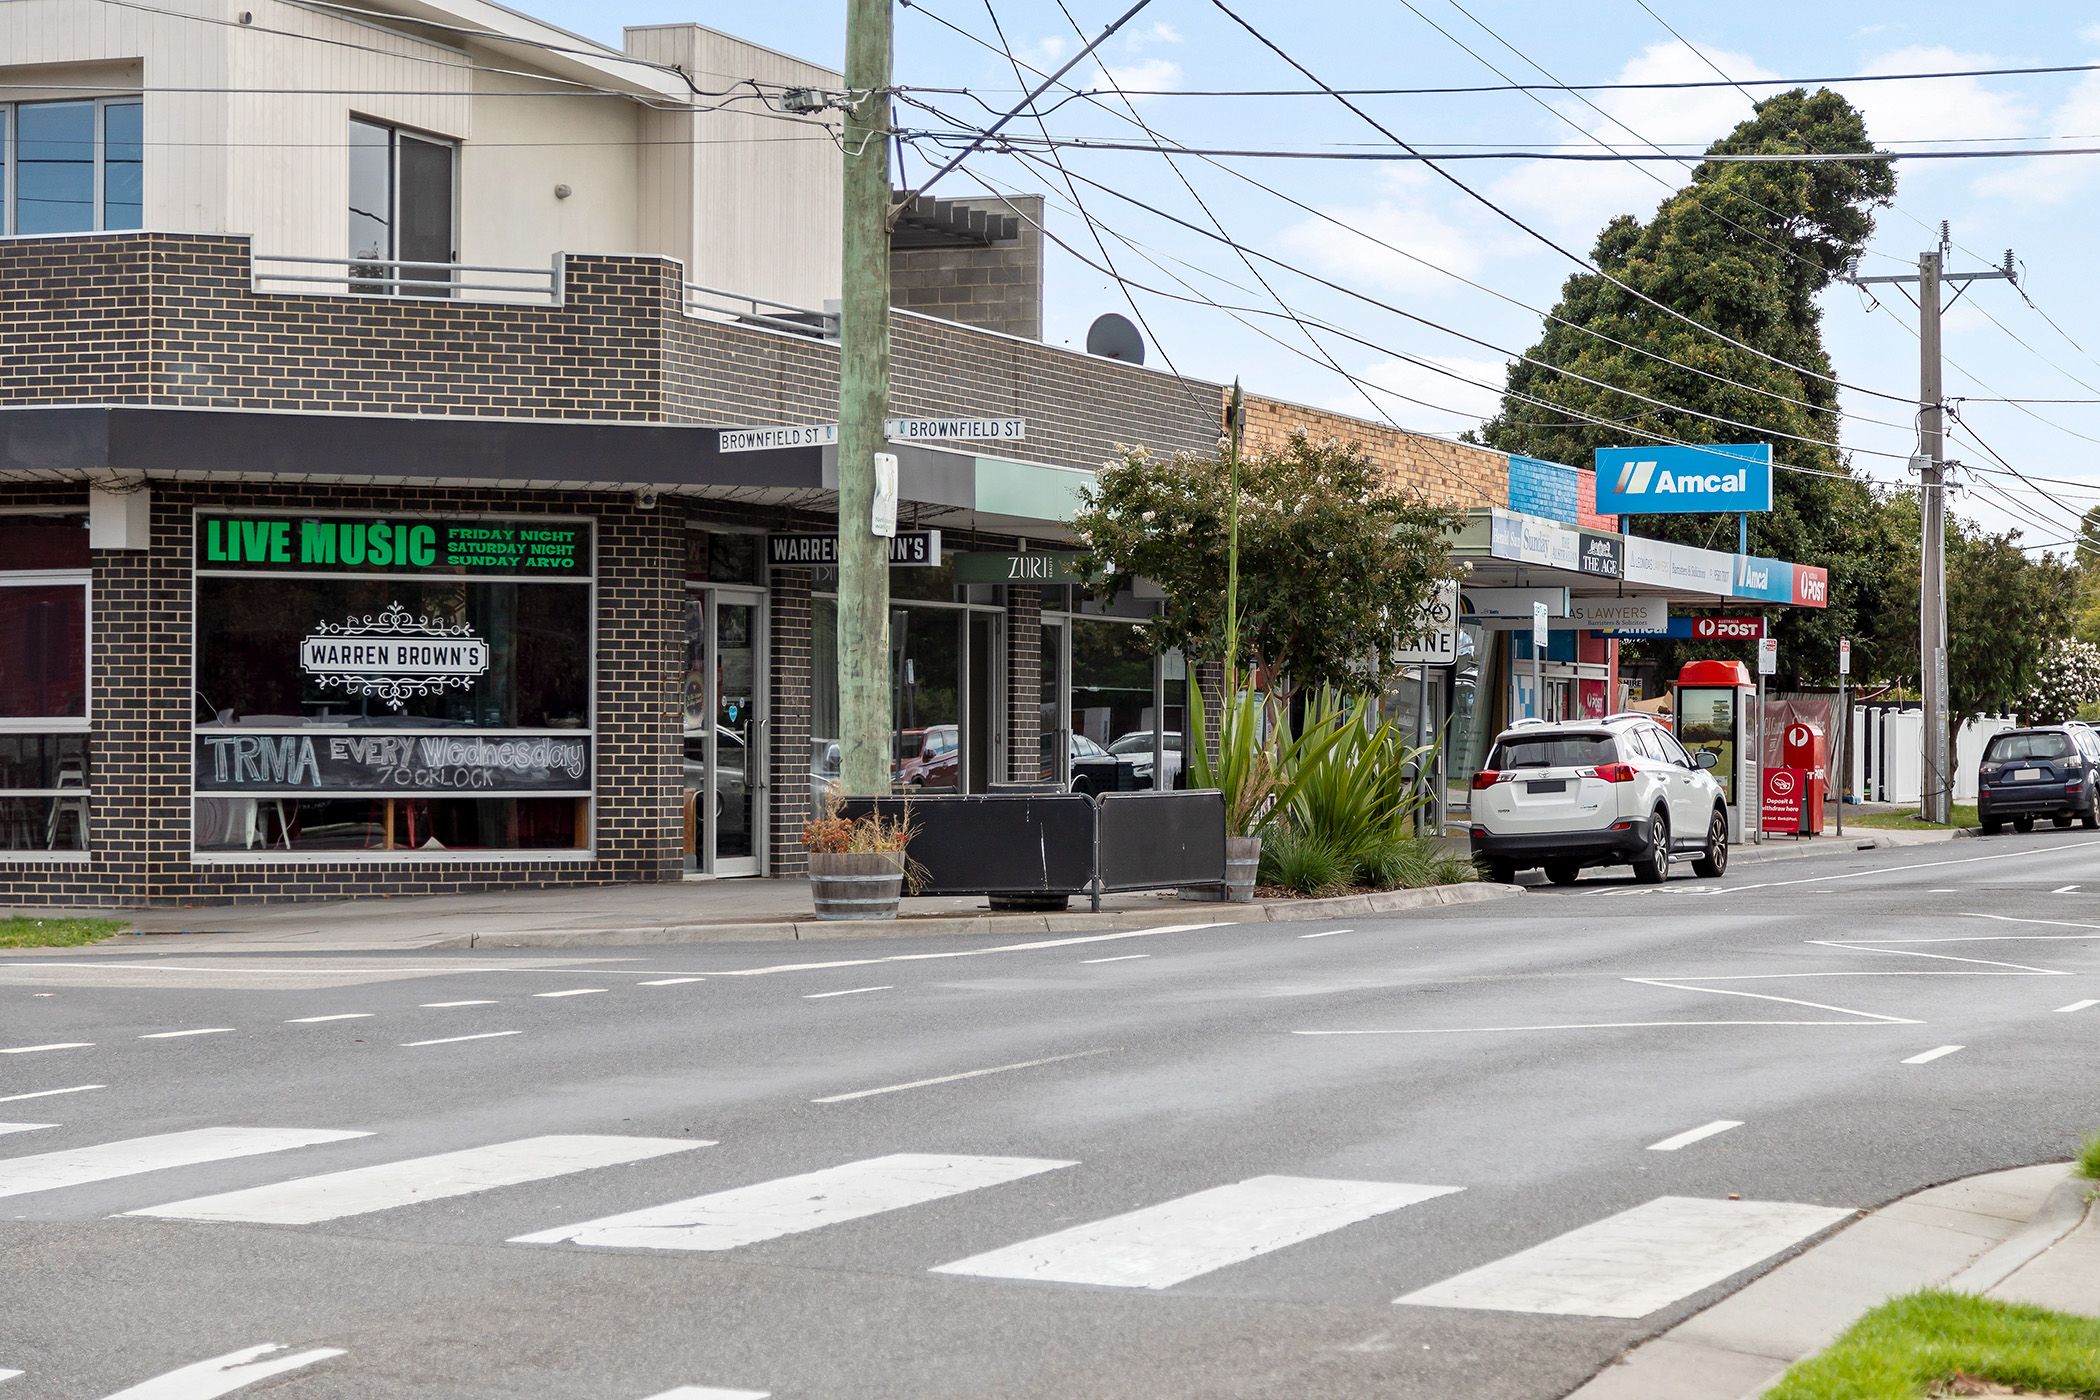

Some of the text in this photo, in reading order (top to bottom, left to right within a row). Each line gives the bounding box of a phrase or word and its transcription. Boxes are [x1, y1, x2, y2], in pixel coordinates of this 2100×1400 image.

[910, 421, 1021, 437] BROWNFIELD ST
[721, 429, 819, 450] BROWNFIELD ST
[1654, 469, 1746, 494] Amcal
[208, 520, 436, 567] LIVE MUSIC
[448, 528, 575, 542] FRIDAY NIGHT
[1523, 528, 1550, 558] Sunday
[447, 542, 575, 556] SATURDAY NIGHT
[447, 555, 575, 568] SUNDAY ARVO
[1007, 557, 1047, 579] ZURI
[1583, 556, 1618, 575] THE AGE
[1746, 565, 1769, 590] Amcal
[1808, 581, 1825, 601] POST
[1588, 607, 1648, 619] LAWYERS
[1718, 623, 1758, 636] POST
[311, 645, 479, 666] WARREN BROWN'S
[329, 737, 415, 767] EVERY
[420, 737, 585, 779] Wednesday
